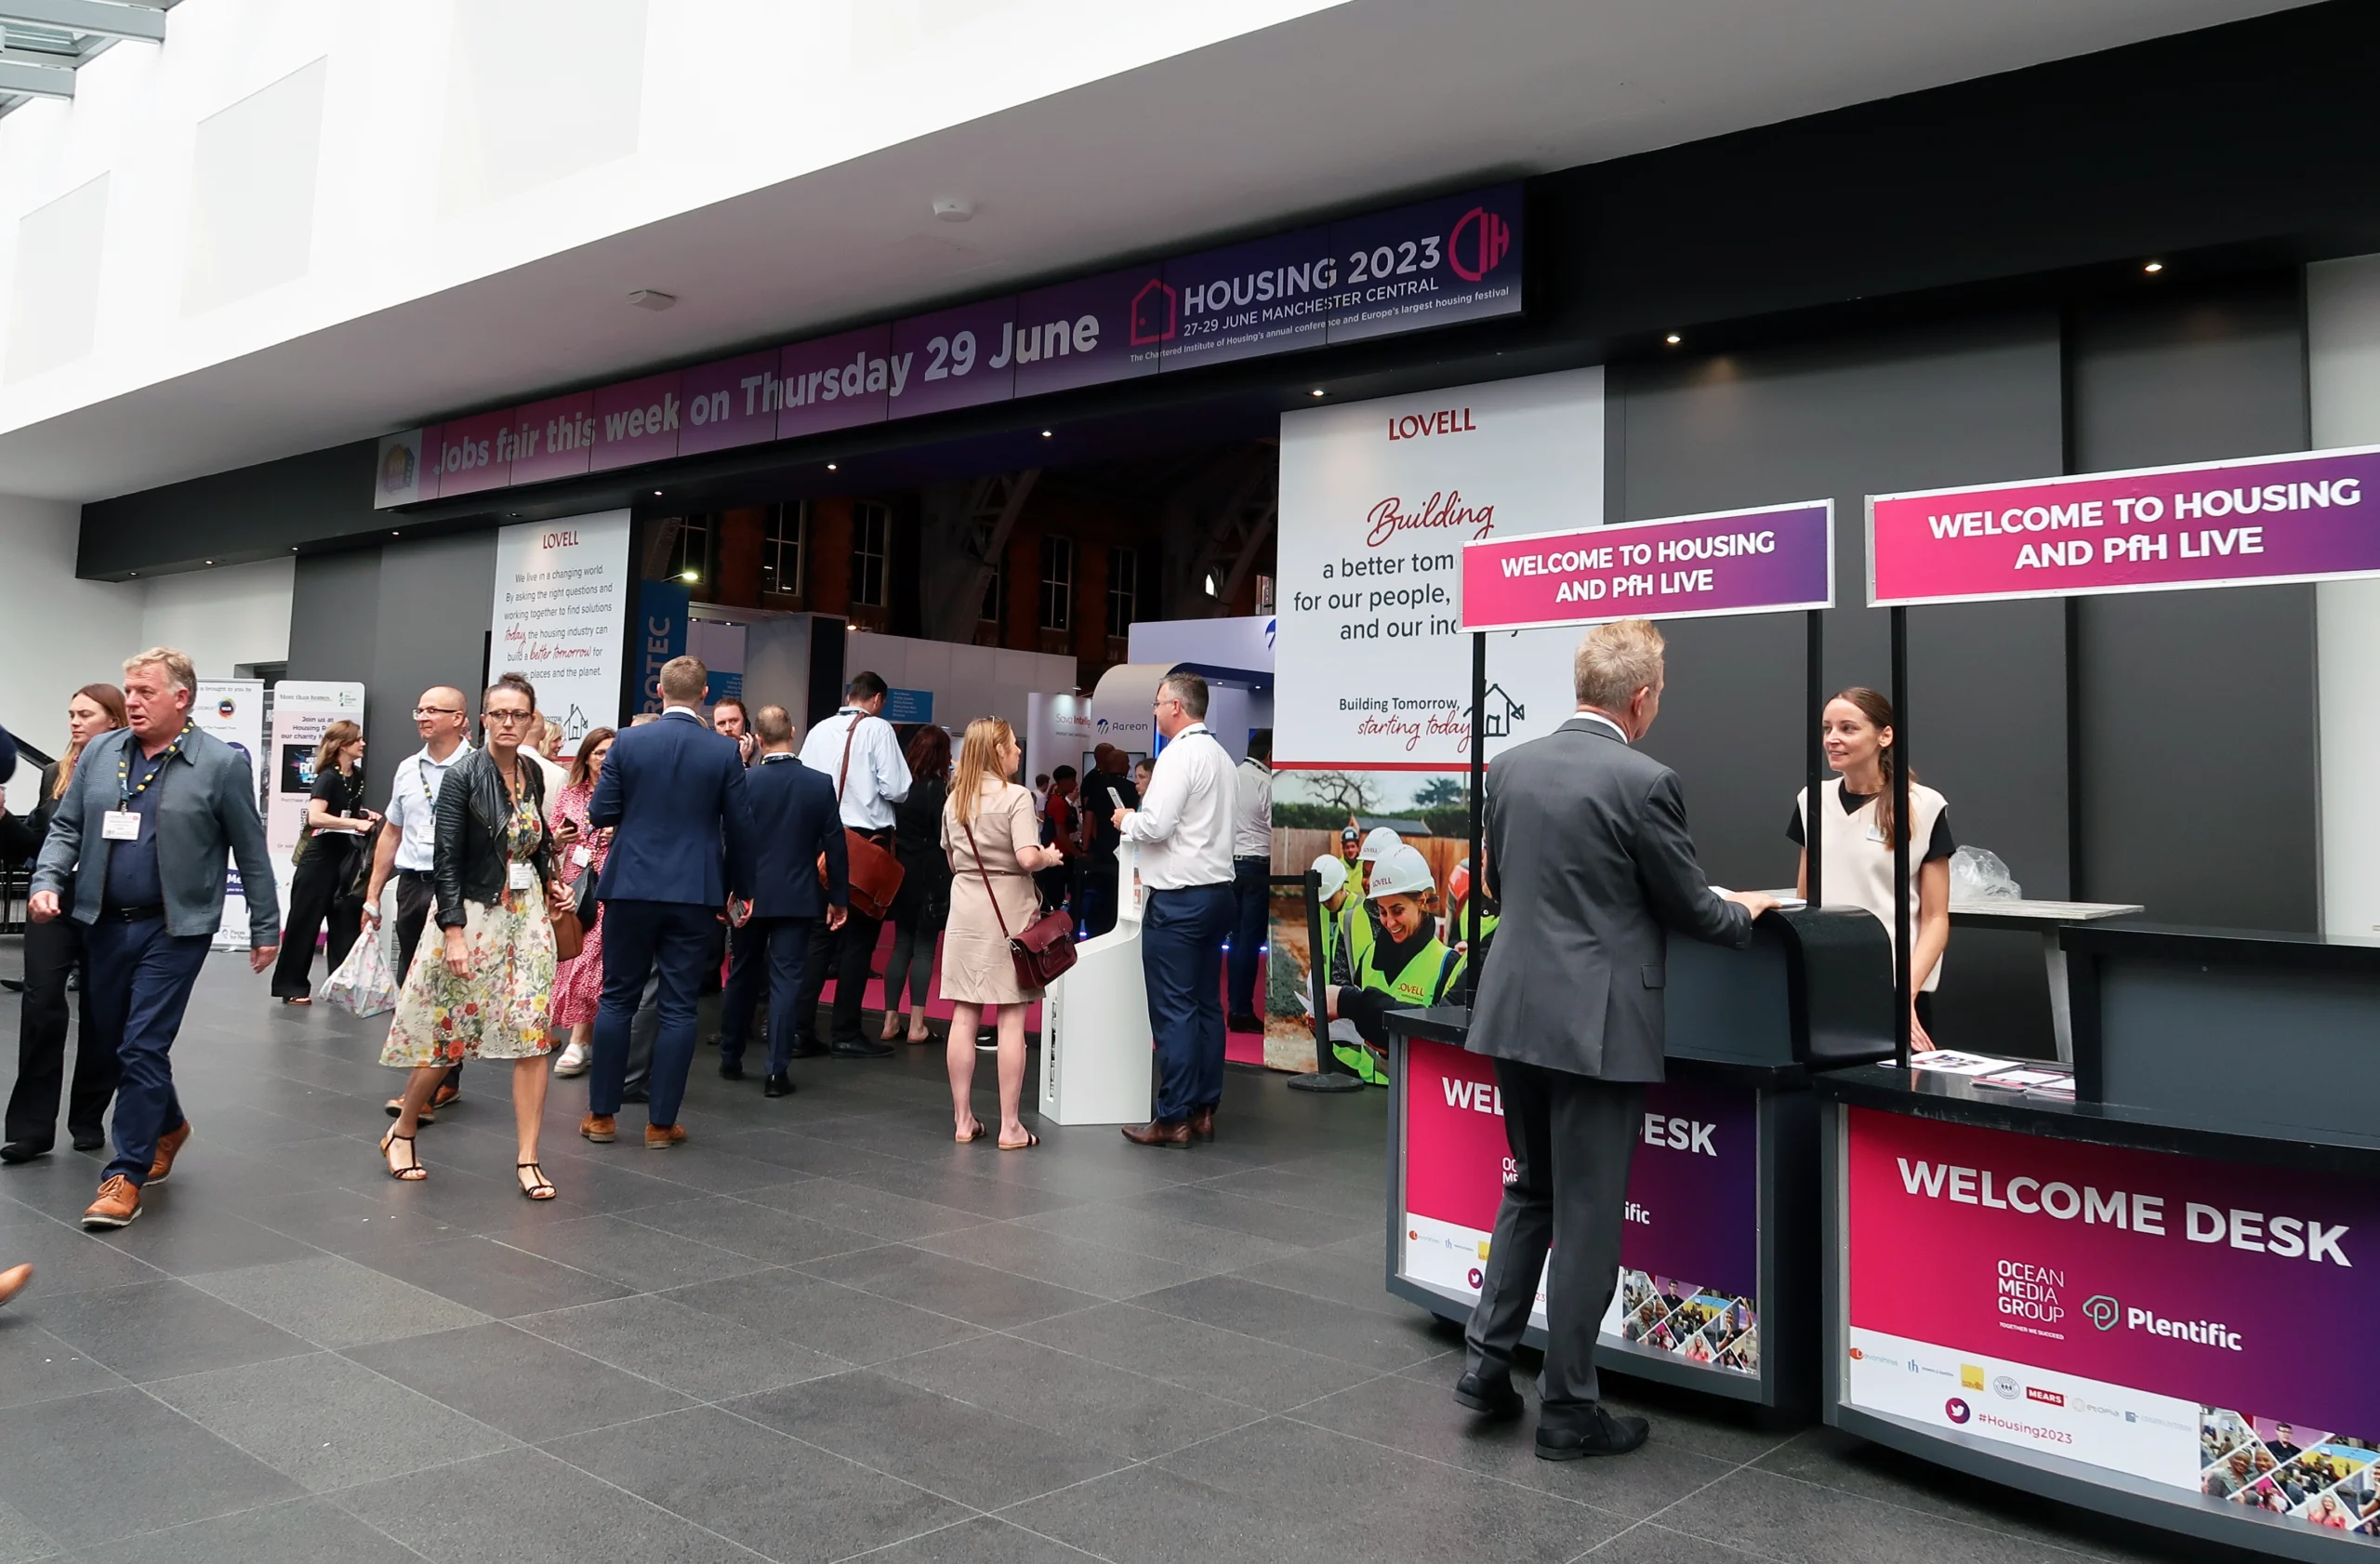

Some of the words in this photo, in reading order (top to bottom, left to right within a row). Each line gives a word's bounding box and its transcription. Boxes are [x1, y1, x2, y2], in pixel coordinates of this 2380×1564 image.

[1183, 258, 1338, 316] HOUSING
[1347, 235, 1441, 284] 2023
[1183, 318, 1219, 337] 27-29
[1222, 311, 1258, 330] JUNE
[1262, 292, 1361, 323] MANCHESTER
[1366, 277, 1439, 302] CENTRAL
[1130, 353, 1144, 363] The
[1144, 346, 1183, 360] Chartered
[1183, 340, 1215, 353] Institute
[1216, 338, 1225, 347] of
[1226, 331, 1264, 345] Housing's
[1265, 326, 1293, 338] annual
[1294, 318, 1341, 333] conference
[1342, 313, 1359, 324] and
[1361, 307, 1399, 321] Europe's
[1401, 301, 1433, 315] largest
[1435, 294, 1473, 308] housing
[1474, 286, 1509, 300] festival
[496, 423, 540, 463] fair
[546, 412, 596, 454] this
[605, 391, 680, 442] week
[690, 388, 730, 426] on
[740, 351, 914, 417] Thursday
[924, 331, 977, 382] 29
[988, 314, 1100, 369] June
[1388, 407, 1476, 441] LOVELL
[1366, 490, 1495, 547] Building
[1928, 500, 2104, 539] WELCOME
[2112, 496, 2164, 524] TO
[2175, 478, 2361, 520] HOUSING
[543, 530, 579, 549] LOVELL
[2014, 539, 2093, 570] AND
[2103, 534, 2168, 564] PfH
[2179, 527, 2265, 557] LIVE
[1322, 563, 1334, 579] a
[1342, 556, 1406, 578] better
[1501, 547, 1614, 578] WELCOME
[1619, 544, 1652, 567] TO
[1658, 531, 1776, 563] HOUSING
[515, 574, 525, 583] We
[526, 572, 537, 582] live
[538, 572, 546, 581] in
[546, 572, 551, 580] a
[551, 566, 583, 580] changing
[1554, 579, 1606, 603] AND
[1611, 574, 1653, 599] PfH
[1660, 568, 1714, 594] LIVE
[506, 592, 514, 603] By
[515, 591, 536, 603] asking
[536, 590, 549, 599] the
[549, 588, 564, 600] right
[565, 585, 598, 598] questions
[599, 583, 613, 593] and
[1294, 591, 1322, 611] for
[1328, 592, 1363, 609] our
[1369, 583, 1450, 612] people,
[504, 610, 529, 621] working
[530, 607, 558, 619] together
[559, 606, 566, 616] to
[567, 604, 580, 615] find
[581, 603, 613, 614] solutions
[527, 630, 538, 640] the
[539, 628, 566, 640] housing
[566, 626, 595, 638] industry
[595, 626, 608, 634] can
[1340, 618, 1380, 640] and
[1386, 619, 1423, 637] our
[523, 653, 528, 661] a
[529, 642, 552, 662] better
[552, 643, 592, 660] tomorrow
[592, 647, 603, 656] for
[530, 667, 551, 681] places
[552, 667, 565, 678] and
[566, 668, 577, 677] the
[1339, 697, 1389, 713] Building
[1392, 698, 1461, 712] Tomorrow,
[1112, 722, 1148, 731] Aareon
[1357, 714, 1421, 751] starting
[1425, 709, 1473, 753] today
[1372, 877, 1393, 888] LOVELL
[1638, 1113, 1718, 1157] ESK
[1897, 1157, 2166, 1236] WELCOME
[2186, 1201, 2353, 1267] DESK
[1997, 1260, 2065, 1288] OCEAN
[1998, 1278, 2059, 1306] MEDIA
[1998, 1296, 2065, 1323] GROUP
[1999, 1321, 2028, 1332] TOGETHER
[2038, 1330, 2065, 1340] SUCCEED
[2126, 1306, 2243, 1351] Plentific
[1907, 1359, 1919, 1373] th
[2028, 1389, 2062, 1404] MEARS
[1977, 1412, 2073, 1445] #Housing2023
